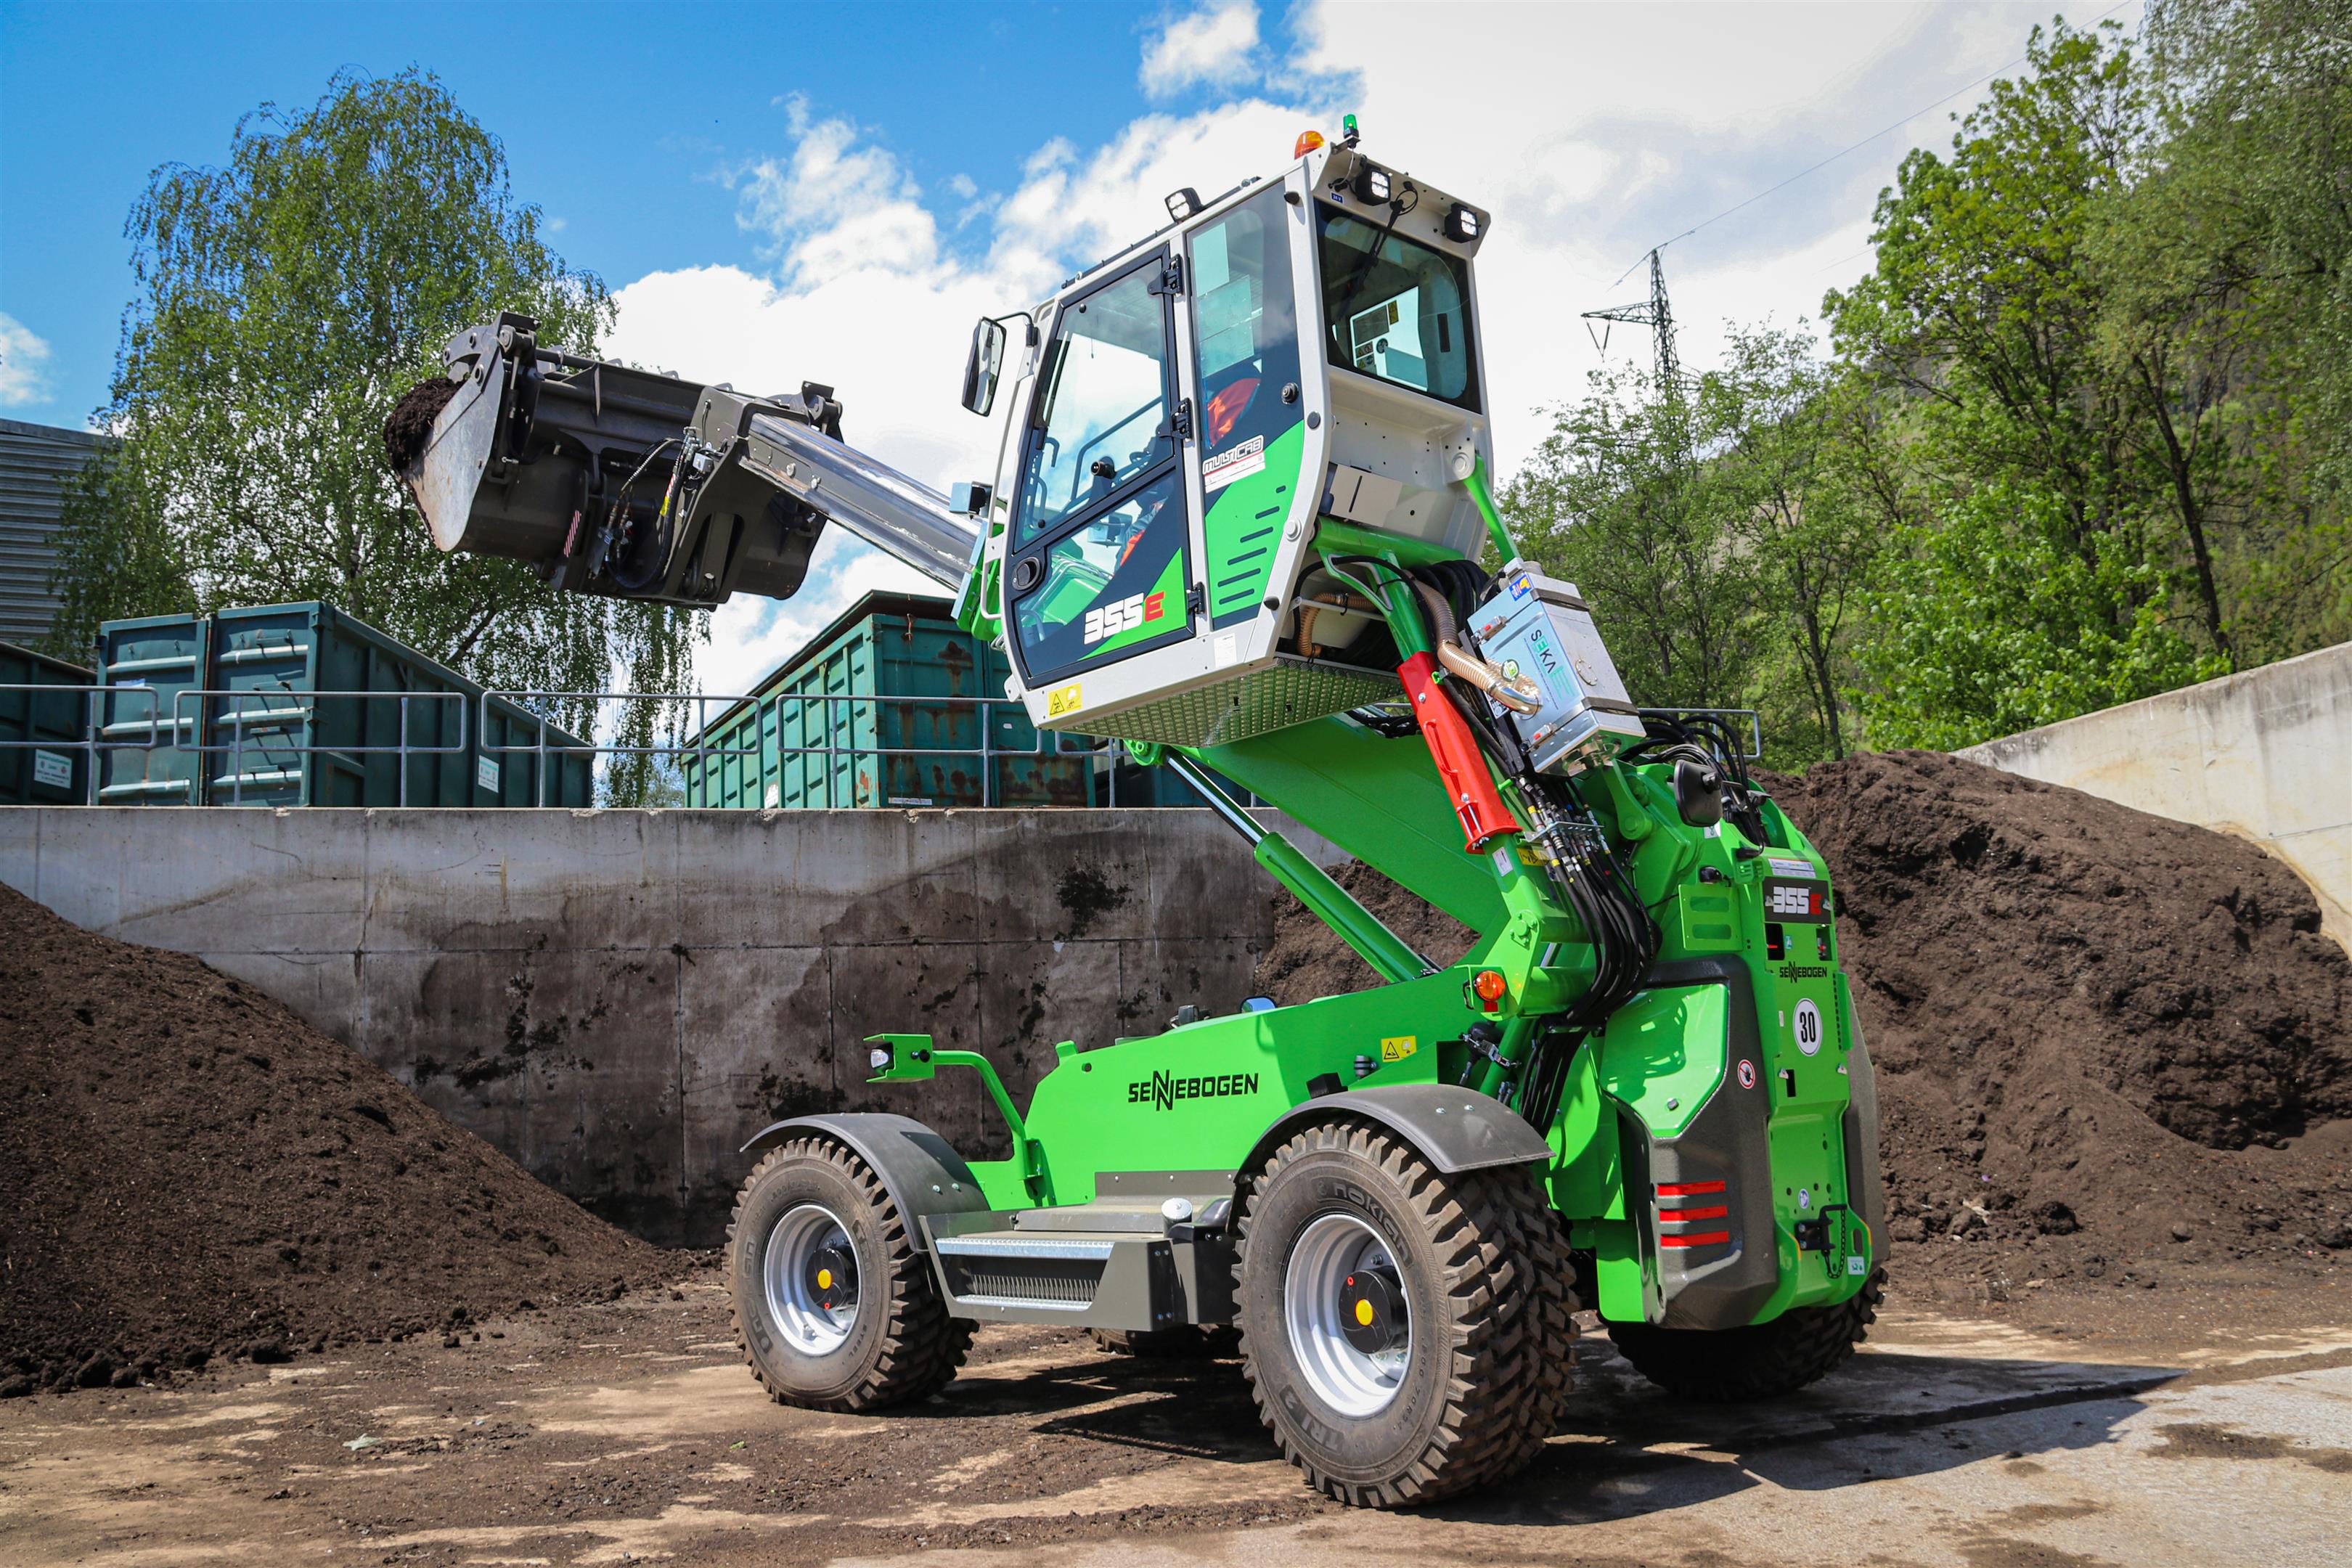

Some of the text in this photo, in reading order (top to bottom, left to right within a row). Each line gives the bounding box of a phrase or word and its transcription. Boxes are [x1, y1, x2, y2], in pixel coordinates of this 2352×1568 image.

[1084, 591, 1164, 645] 355E
[1773, 886, 1822, 915] 355E
[1779, 960, 1827, 984] SENNEBOGEN
[1800, 1011, 1816, 1043] 30
[1128, 1069, 1259, 1111] SENNEBOGEN
